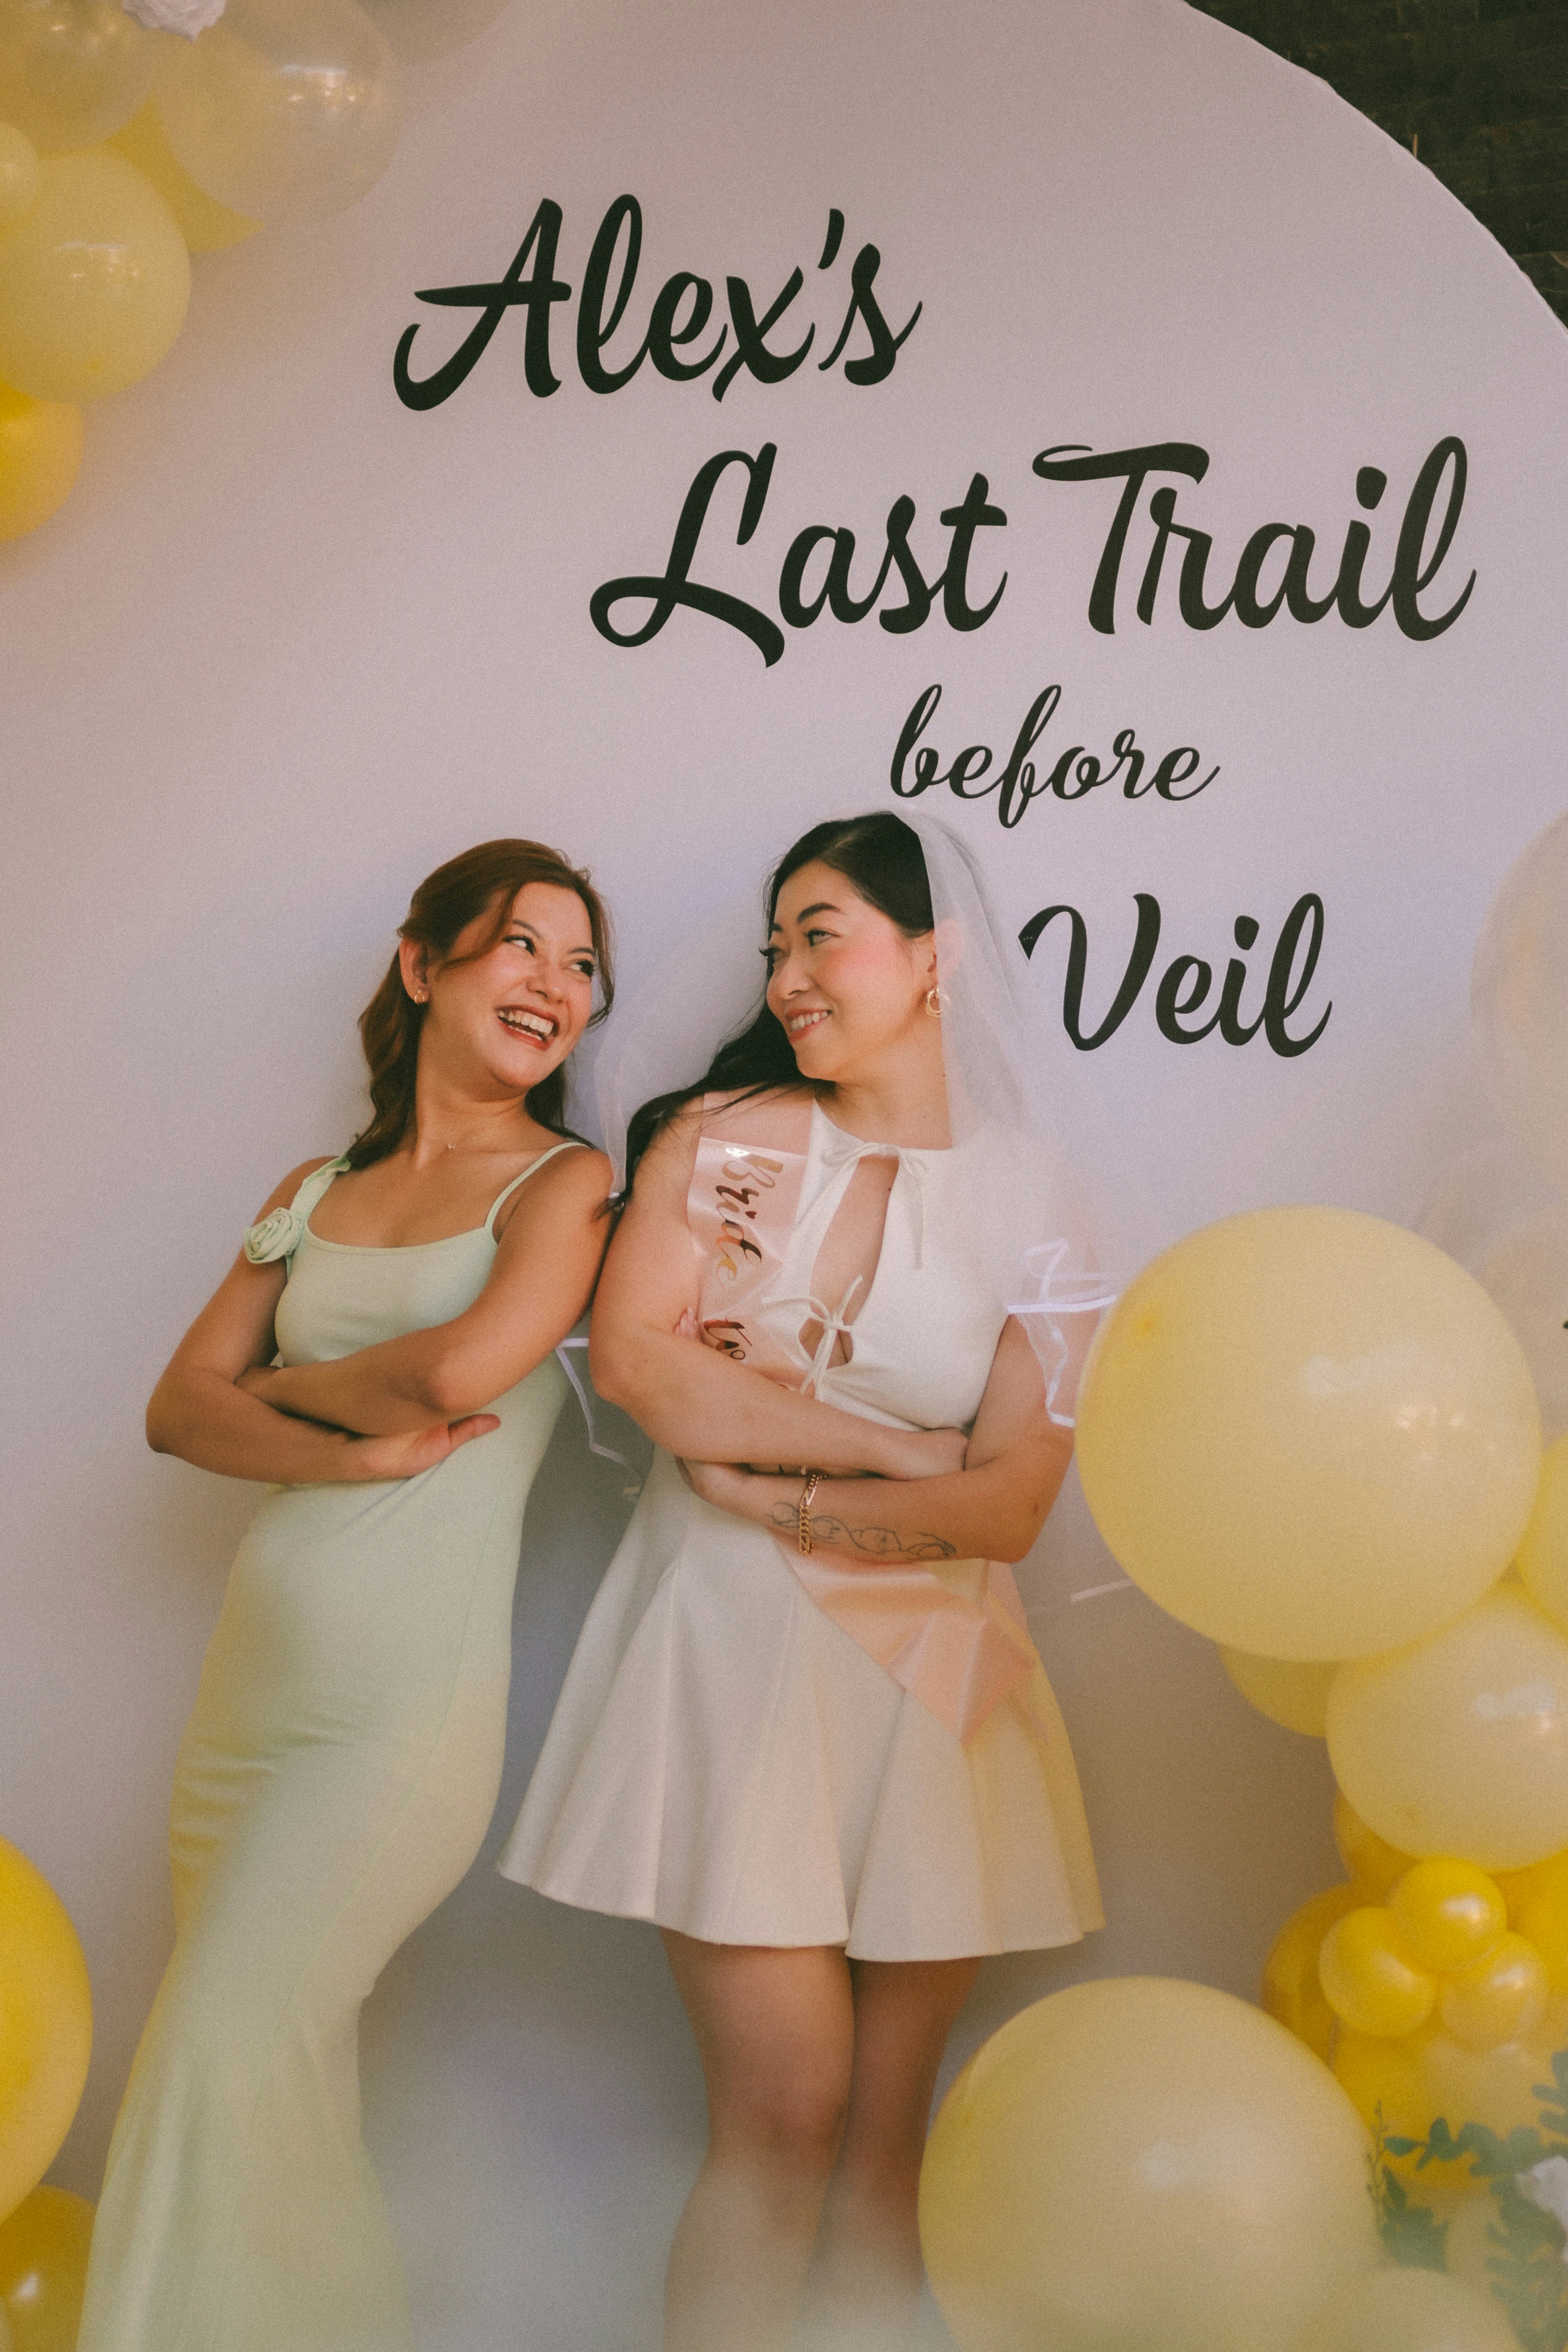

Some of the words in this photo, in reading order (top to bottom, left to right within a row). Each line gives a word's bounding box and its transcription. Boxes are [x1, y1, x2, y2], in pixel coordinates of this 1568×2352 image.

[392, 193, 923, 412] Alex's
[589, 441, 1008, 668] Last
[1031, 436, 1477, 642] Trail
[890, 683, 1221, 829] before
[1017, 892, 1333, 1058] Veil
[715, 1147, 784, 1289] Bride
